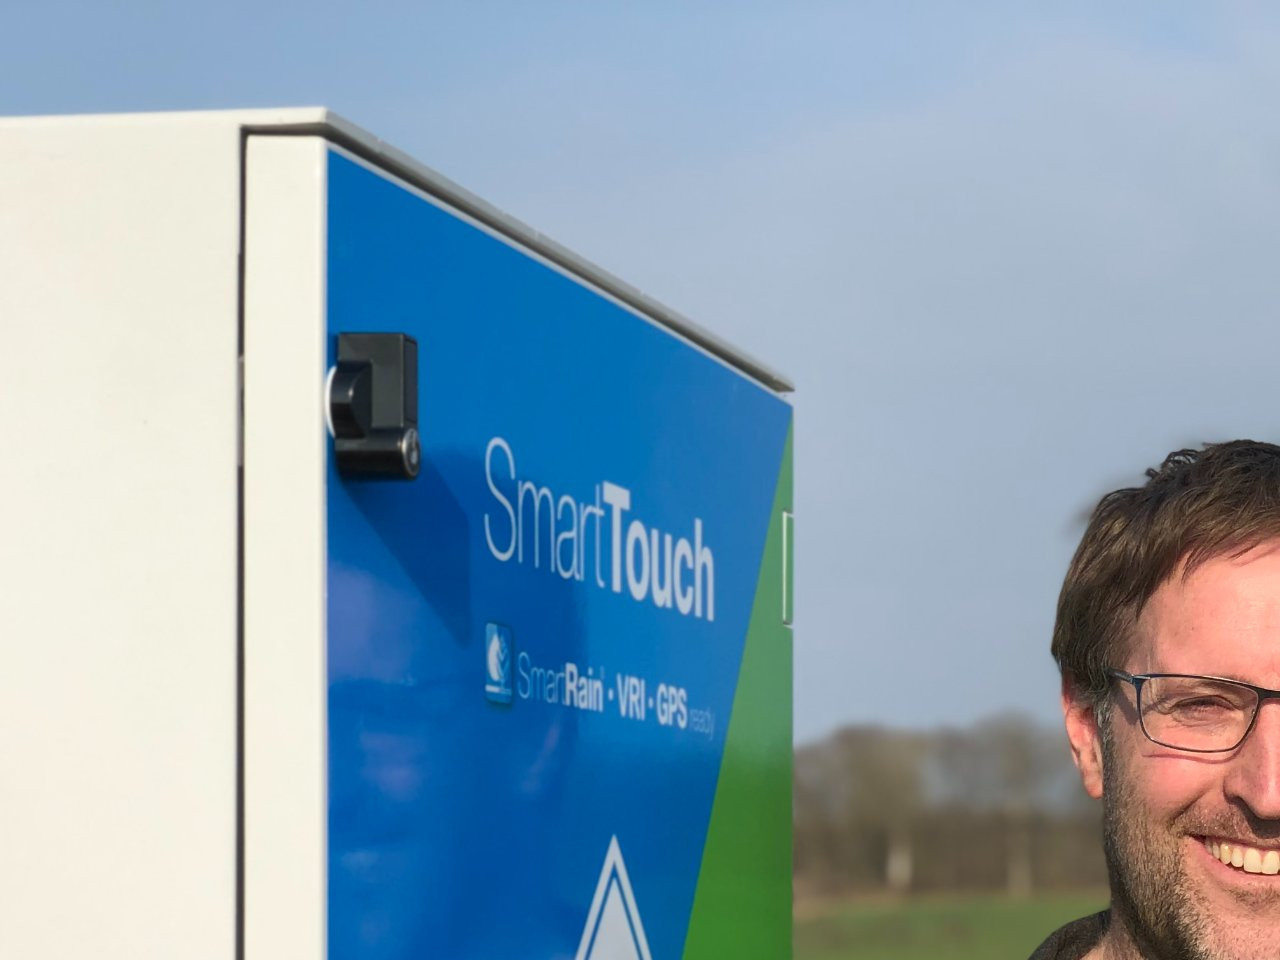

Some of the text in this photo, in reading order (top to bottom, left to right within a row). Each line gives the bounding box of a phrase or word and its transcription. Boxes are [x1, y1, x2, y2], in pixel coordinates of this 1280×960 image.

[484, 436, 715, 622] SmartTouch
[616, 672, 645, 721] VRI
[657, 682, 688, 730] GPS
